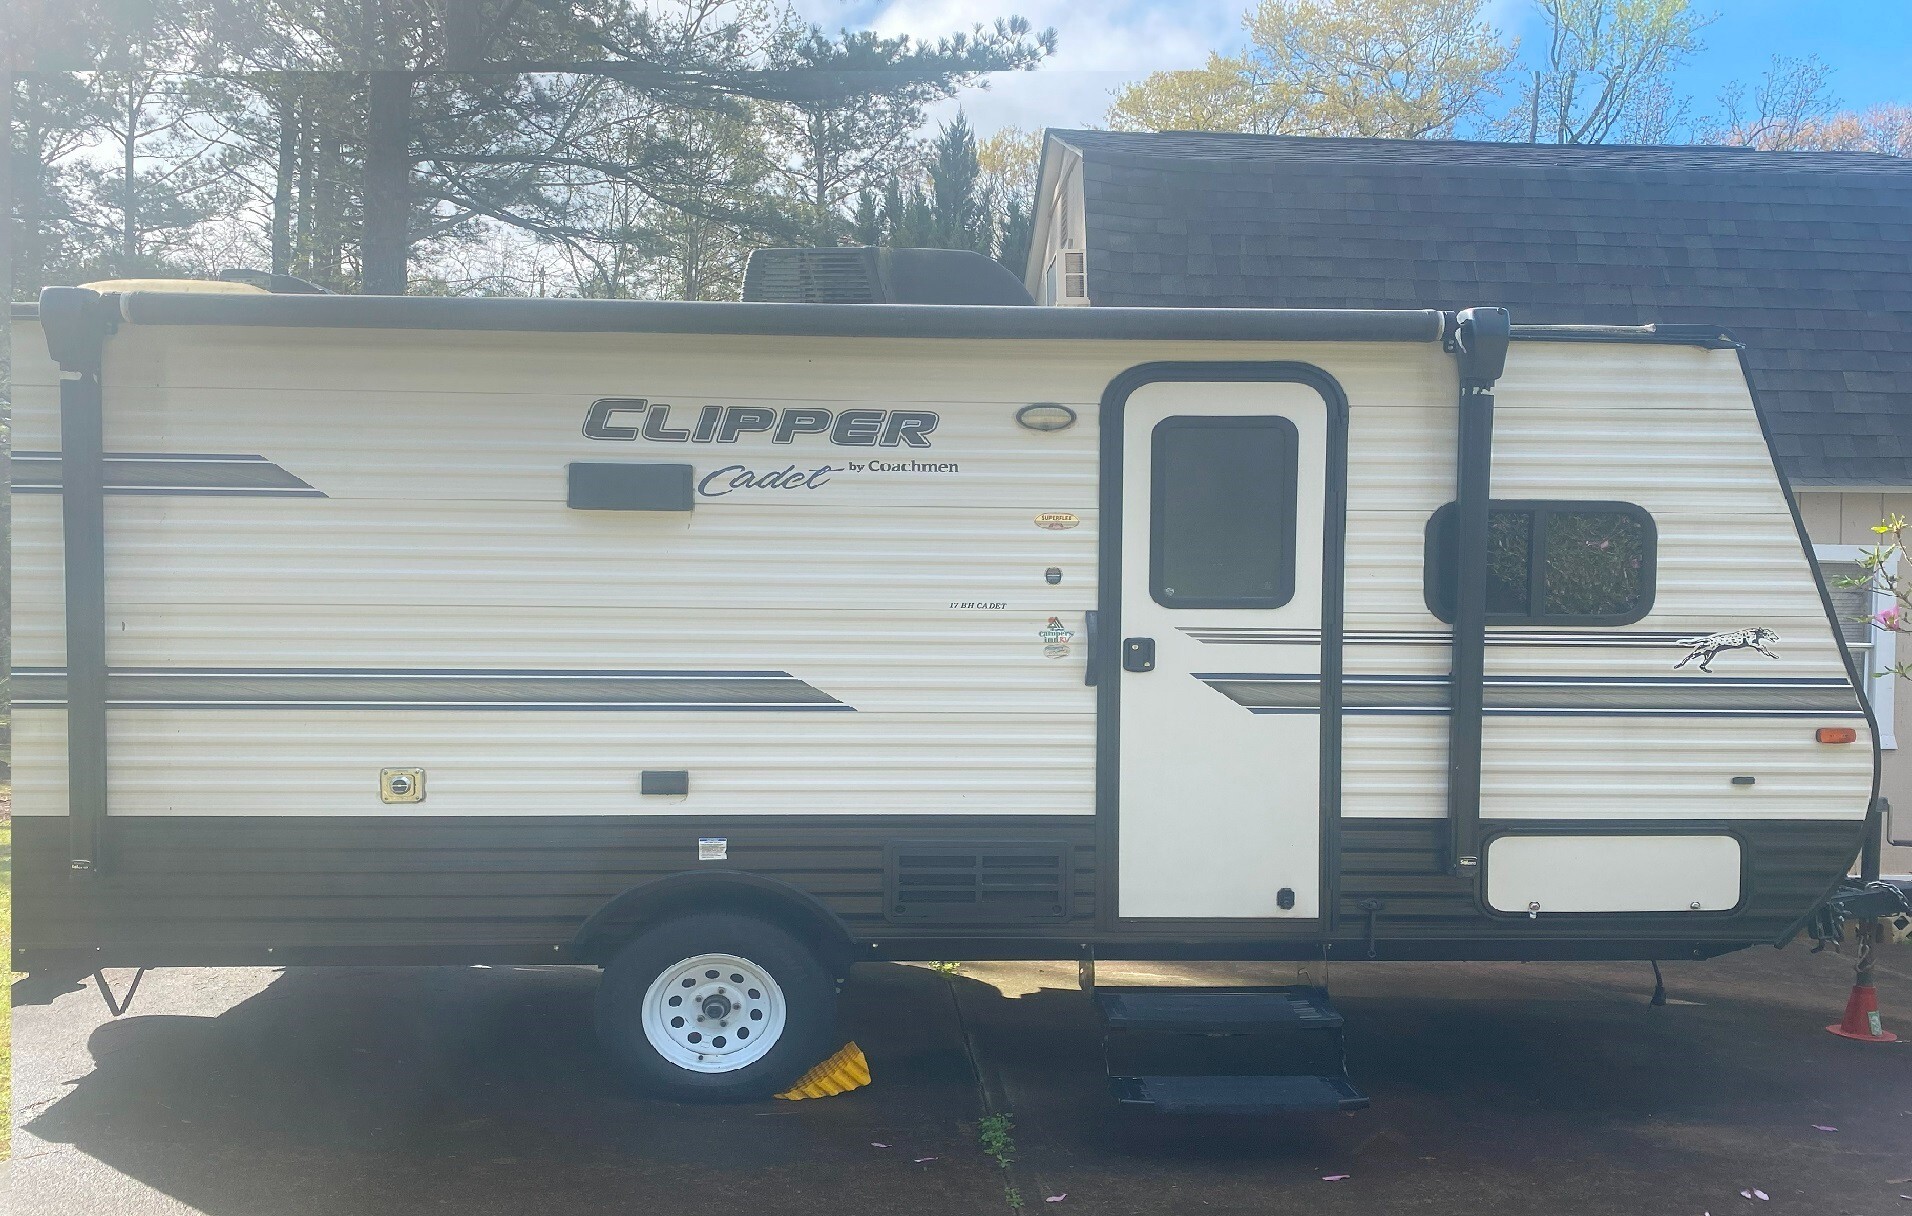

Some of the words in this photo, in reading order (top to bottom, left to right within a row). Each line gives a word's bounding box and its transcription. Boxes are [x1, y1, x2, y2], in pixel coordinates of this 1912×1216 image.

[582, 398, 940, 448] CLIPPER
[698, 464, 845, 497] Cadet
[848, 462, 865, 473] by
[868, 460, 959, 473] Coachmen
[976, 602, 1008, 610] CADET
